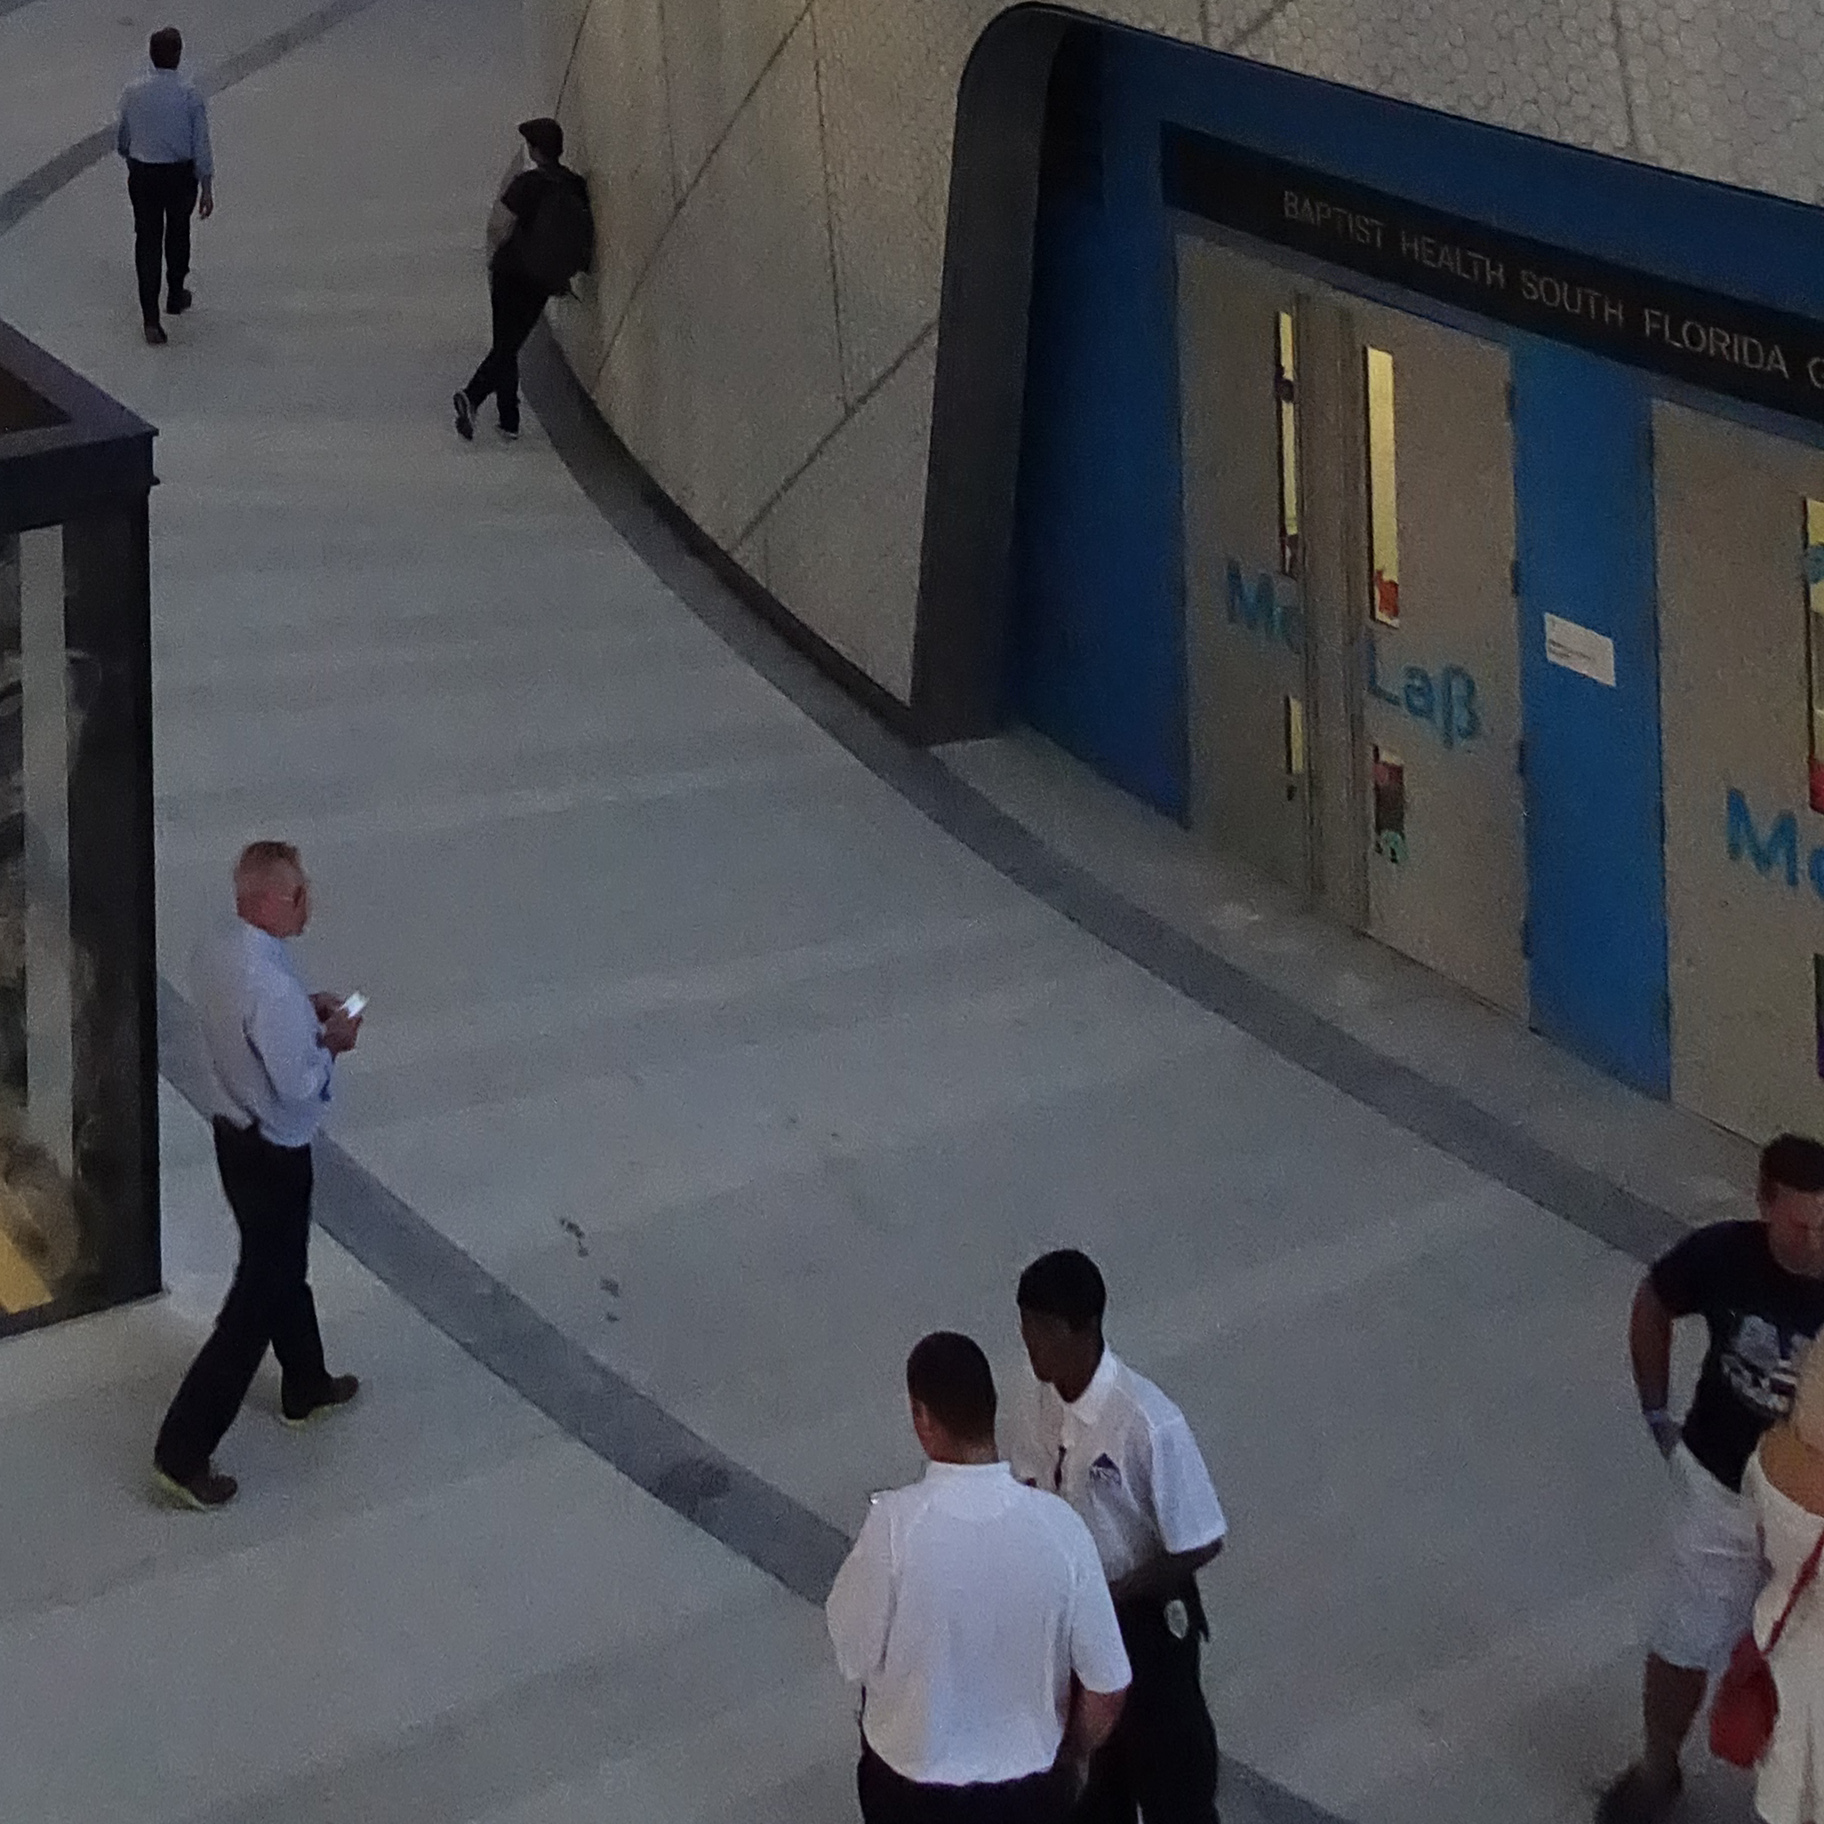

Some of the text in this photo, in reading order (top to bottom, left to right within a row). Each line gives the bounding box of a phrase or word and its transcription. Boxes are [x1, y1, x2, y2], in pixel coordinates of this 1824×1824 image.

[1283, 190, 1384, 249] BAPTIST
[1401, 230, 1505, 289] HEALTH
[1520, 269, 1624, 328] SOUTH
[1644, 308, 1790, 379] FLORIDA
